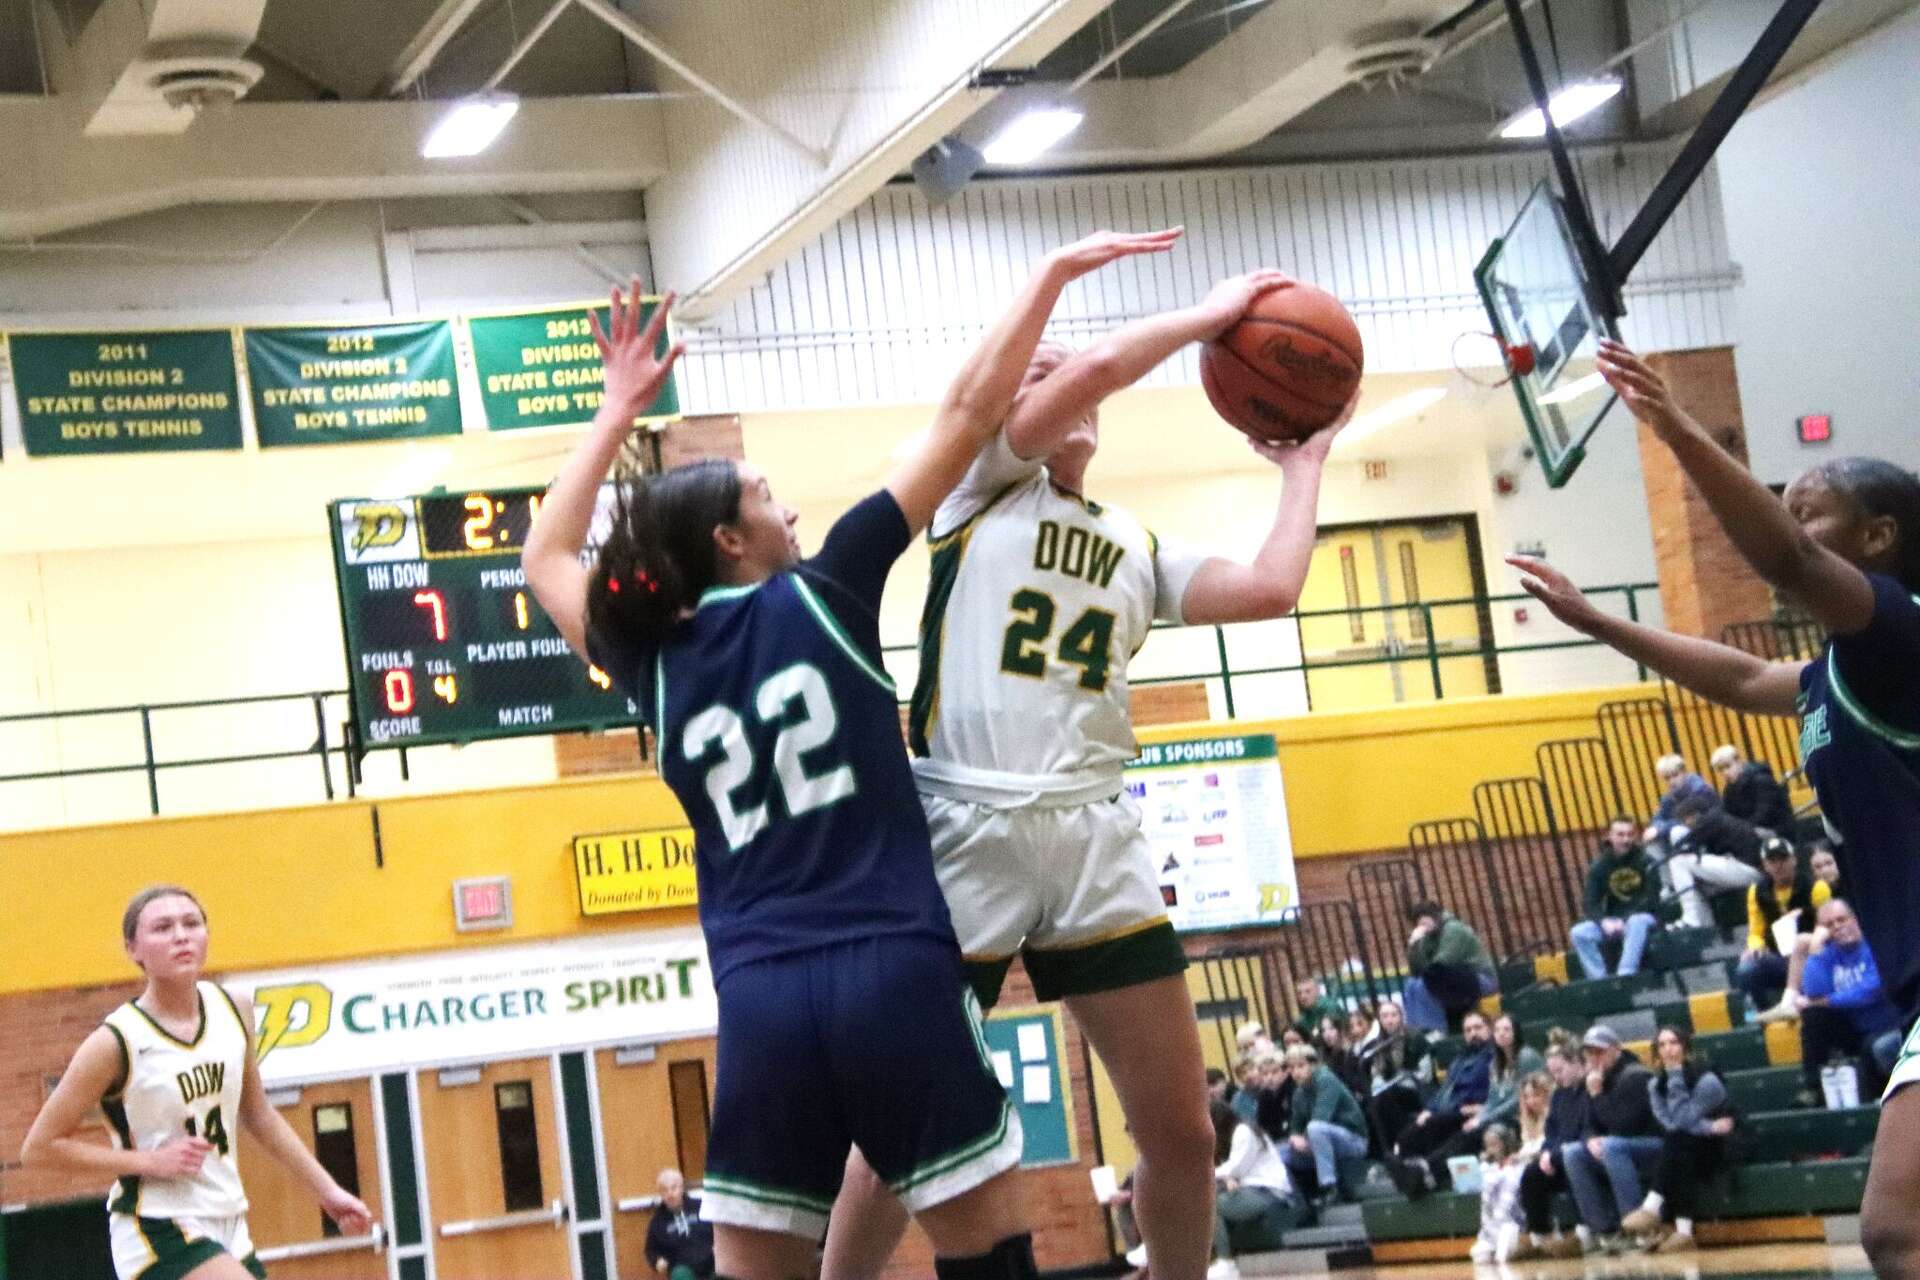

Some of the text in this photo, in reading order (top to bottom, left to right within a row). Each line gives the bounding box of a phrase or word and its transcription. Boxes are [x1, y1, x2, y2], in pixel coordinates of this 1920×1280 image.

[99, 344, 146, 361] 2011
[328, 335, 374, 352] 2012
[69, 368, 183, 387] DIVISION 2
[301, 357, 407, 378] DIVISION 2
[263, 379, 450, 406] STATE CHAMPIONS
[487, 371, 547, 393] STATE
[28, 392, 228, 413] STATE CHAMPIONS
[517, 394, 569, 415] BOYS
[61, 419, 203, 438] BOYS TENNIS
[295, 406, 427, 429] BOYS TENNIS
[1034, 520, 1124, 588] DOW
[367, 563, 429, 590] HH DOW
[414, 590, 448, 641] 7
[514, 591, 529, 630] 1
[1000, 587, 1117, 692] 24
[362, 651, 413, 671] FOULS
[467, 641, 527, 662] PLAYER
[385, 670, 413, 714] 0
[434, 675, 457, 704] 4
[499, 705, 552, 725] MATCH
[370, 717, 421, 741] SCORE
[683, 663, 855, 852] 22
[1165, 739, 1245, 762] SPONSORS
[583, 843, 614, 876] H.
[622, 839, 653, 873] H.
[342, 988, 547, 1035] CHARGER
[564, 957, 699, 1013] SPIRIT
[177, 1061, 225, 1104] DOW
